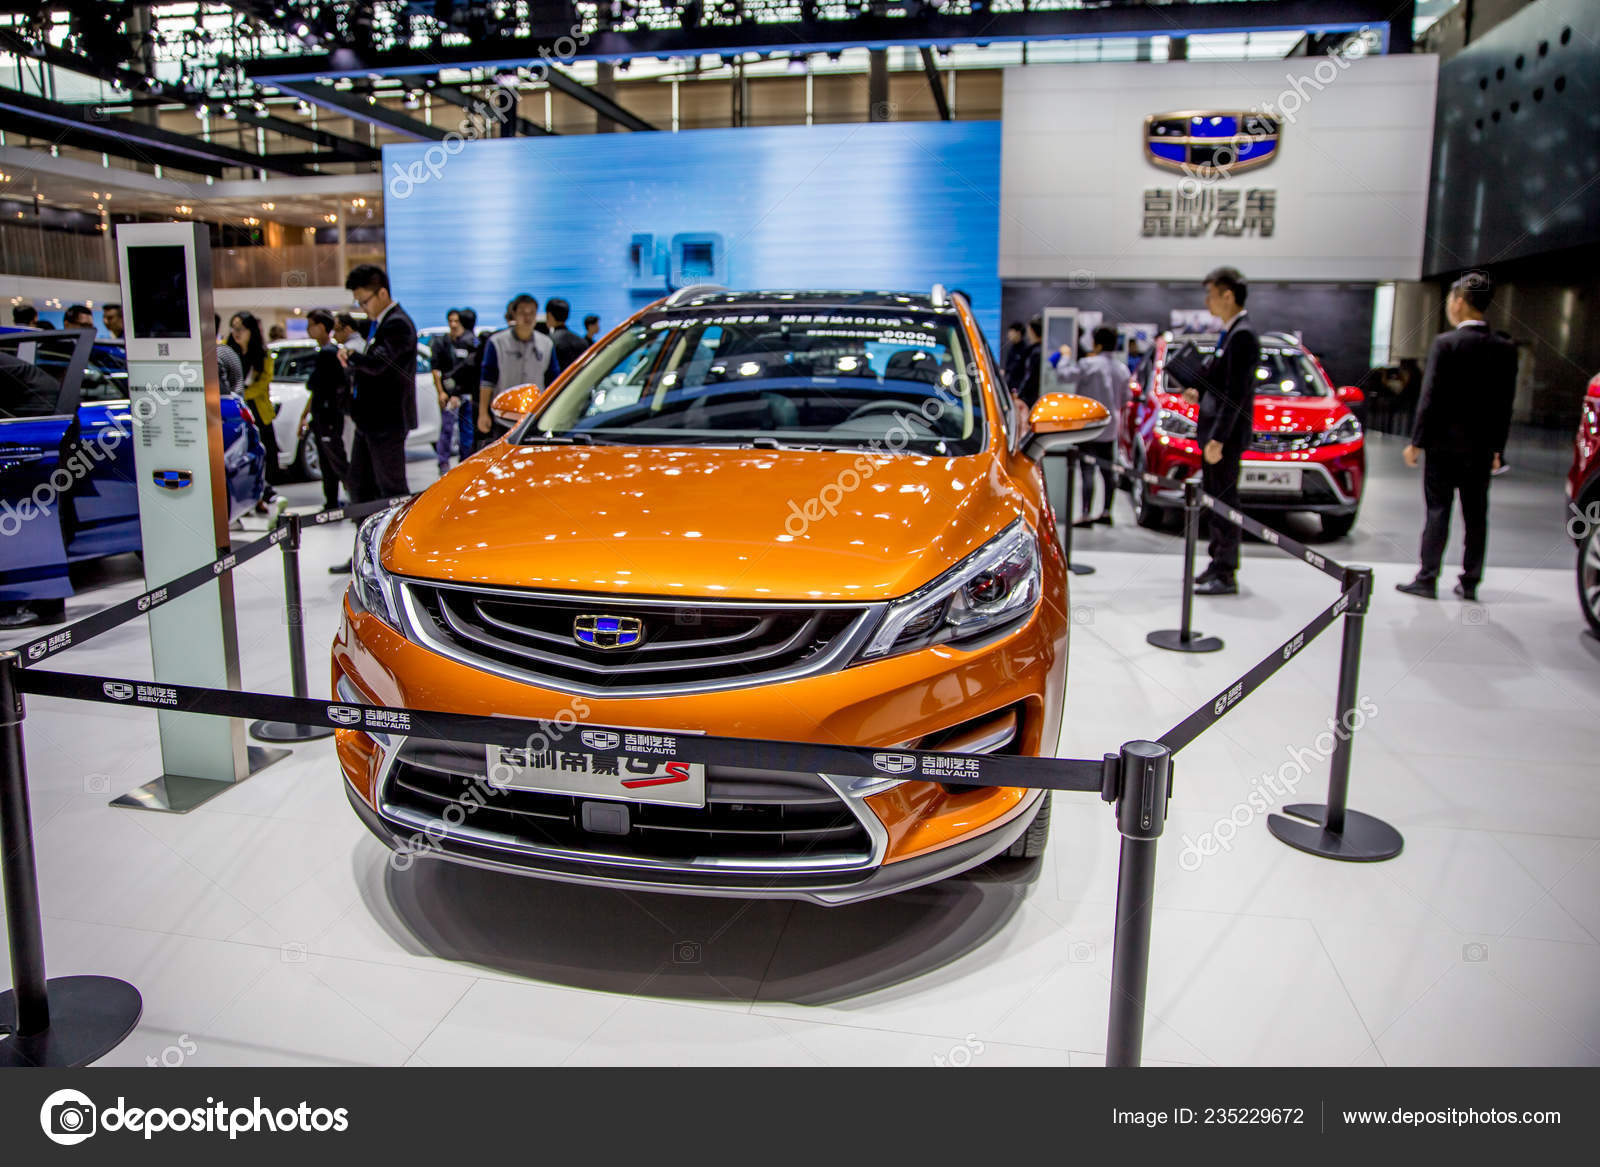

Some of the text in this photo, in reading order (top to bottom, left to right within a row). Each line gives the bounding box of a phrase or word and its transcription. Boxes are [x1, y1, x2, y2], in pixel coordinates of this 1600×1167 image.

[1143, 188, 1276, 215] 吉利汽车
[137, 685, 177, 698] 吉利汽车
[365, 709, 410, 723] 吉利汽车
[390, 721, 411, 730] AUTO
[625, 733, 676, 749] 吉利汽车
[625, 744, 676, 755] GEELY AUTO
[922, 756, 980, 771] 吉利汽车
[922, 768, 980, 778] GEELY AUTO
